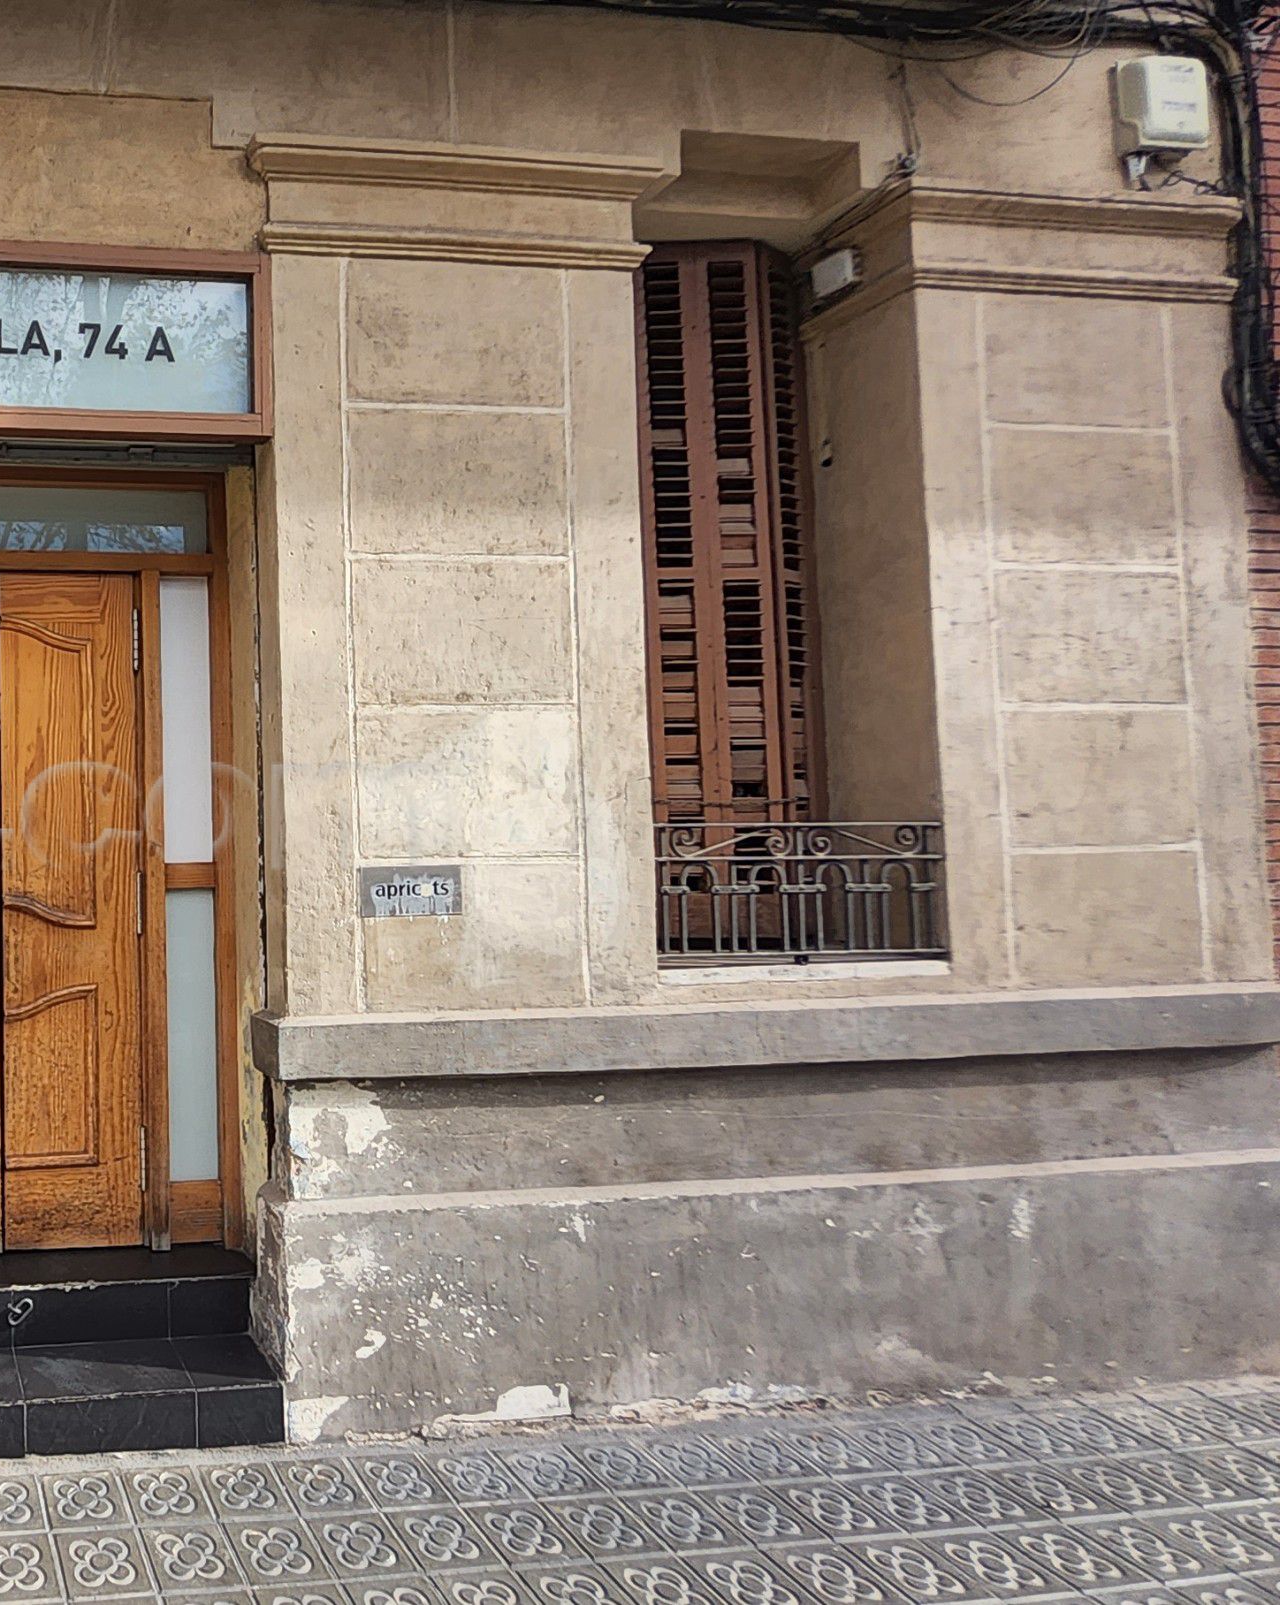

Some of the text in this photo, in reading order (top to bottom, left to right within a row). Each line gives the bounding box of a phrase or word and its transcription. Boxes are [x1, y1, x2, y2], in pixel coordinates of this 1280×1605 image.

[78, 322, 129, 361] 74
[144, 326, 176, 363] A
[375, 880, 450, 900] apricts
